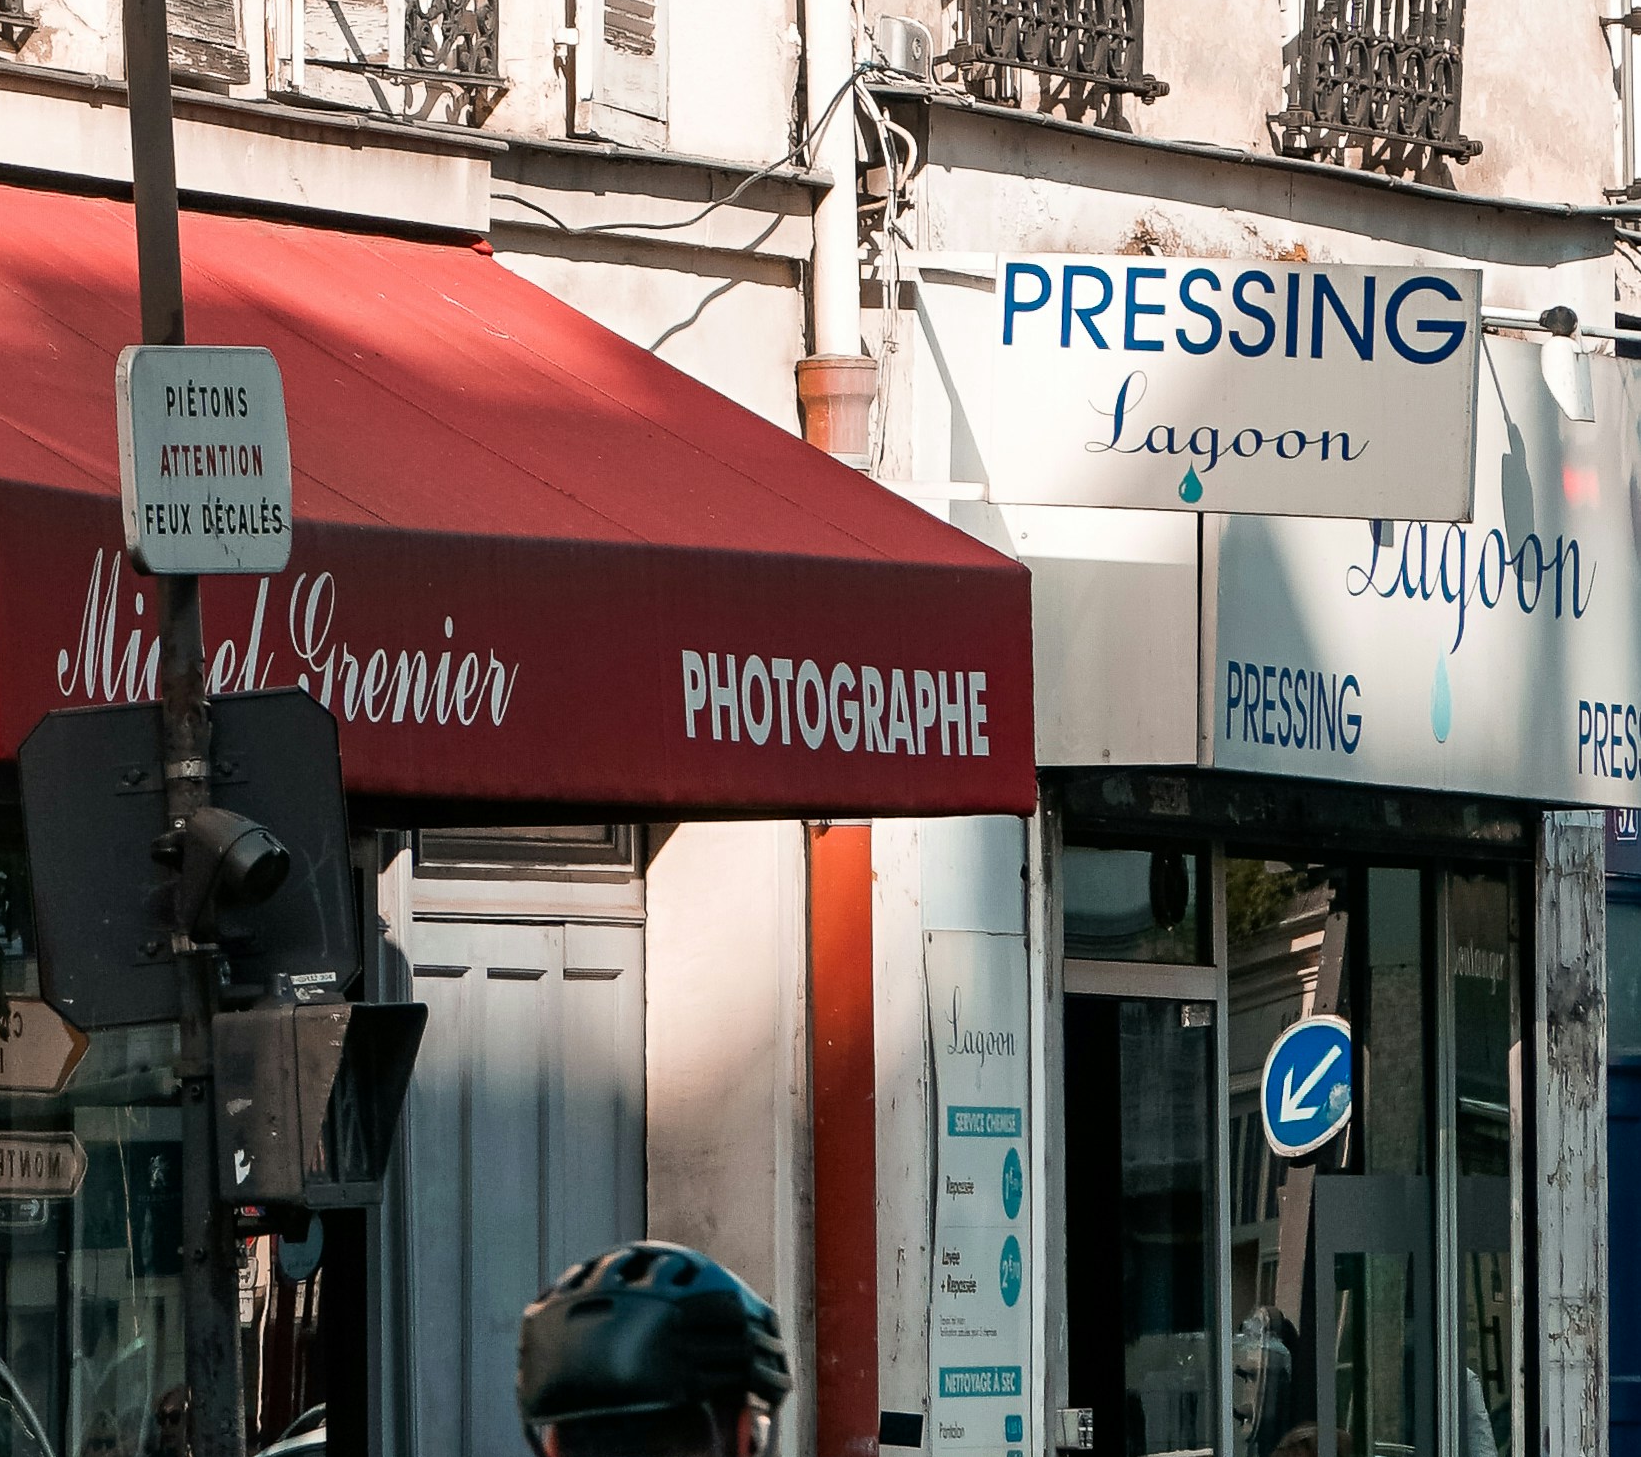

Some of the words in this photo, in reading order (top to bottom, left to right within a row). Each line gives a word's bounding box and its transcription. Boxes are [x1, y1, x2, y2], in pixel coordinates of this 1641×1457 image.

[1002, 262, 1467, 364] PRESSING
[166, 379, 248, 417] PIÉTONS
[1084, 370, 1369, 473] Lagoon
[161, 445, 263, 477] ATTENTION
[145, 503, 191, 535] FEUX
[201, 497, 283, 535] DÉCALÉS
[1346, 521, 1597, 655] Lagoon
[289, 571, 519, 726] Grenier
[681, 649, 989, 757] PHOTOGRAPHE
[1226, 660, 1362, 754] PRESSING
[944, 985, 1015, 1069] Lagoon
[955, 1112, 984, 1133] SERVICE
[986, 1113, 1016, 1133] CHEMISE
[945, 1373, 992, 1393] NETTOYAGE
[1002, 1372, 1016, 1392] SEC
